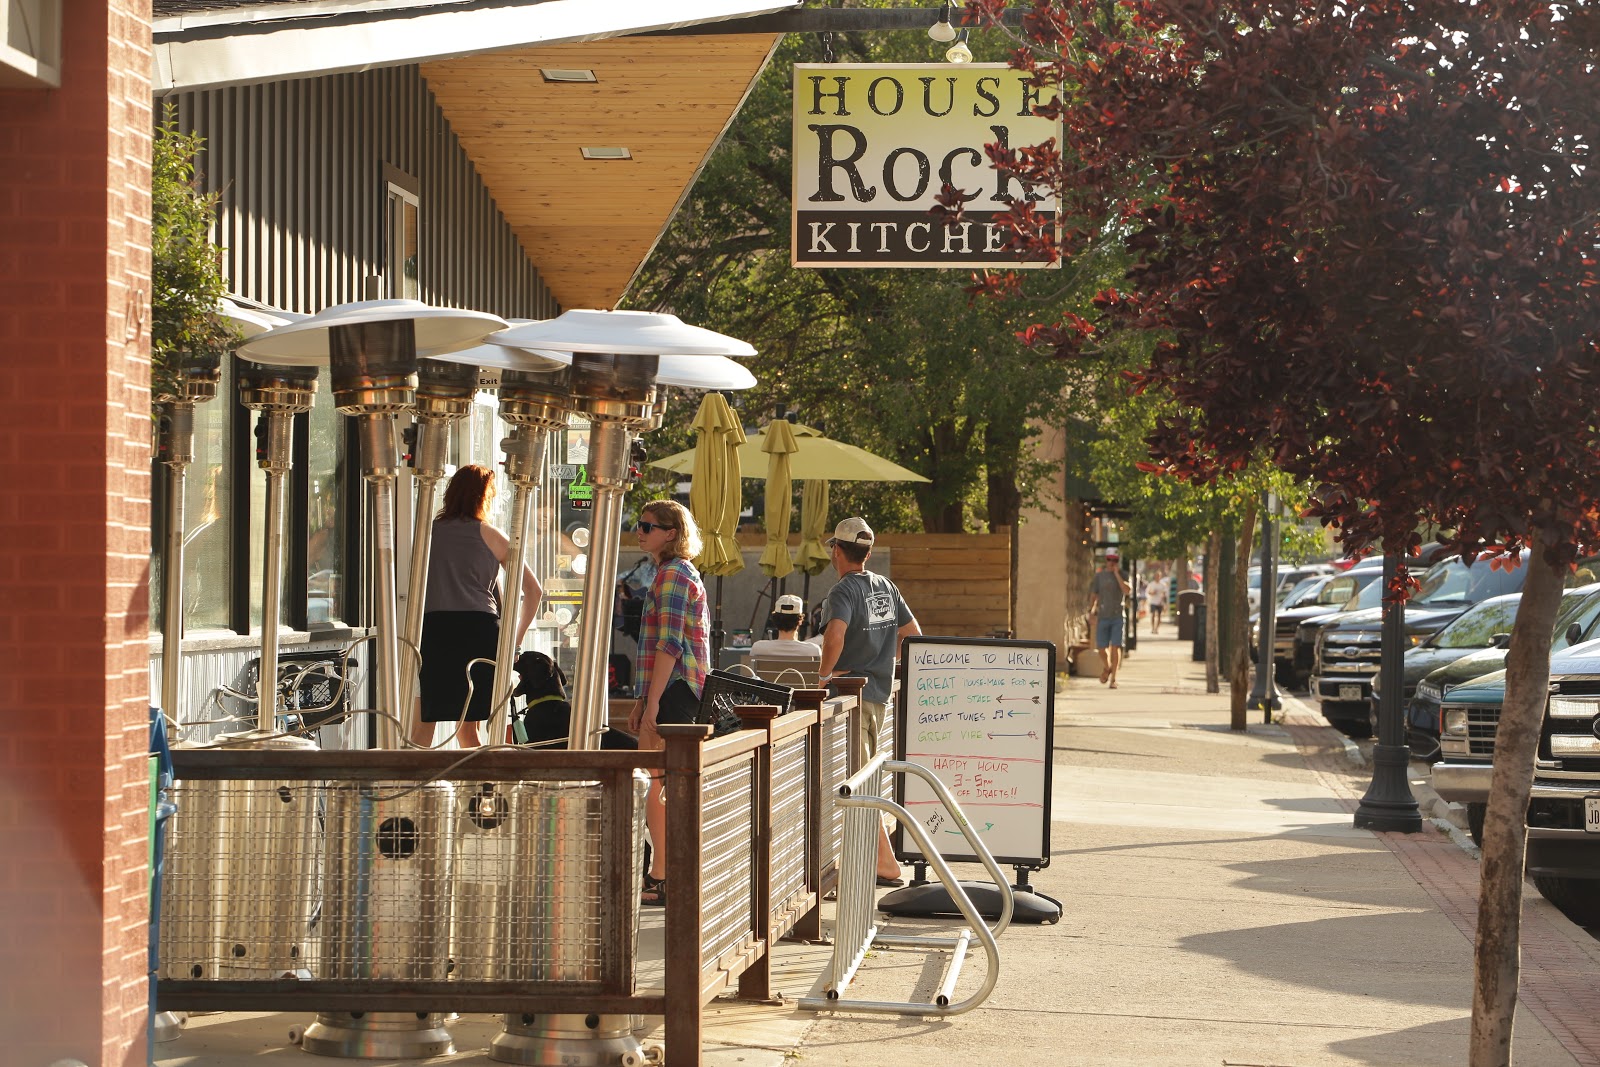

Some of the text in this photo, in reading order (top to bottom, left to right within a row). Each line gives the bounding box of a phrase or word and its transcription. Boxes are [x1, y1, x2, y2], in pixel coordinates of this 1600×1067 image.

[807, 76, 1042, 117] HOUSE
[807, 222, 1044, 253] KITCHE
[914, 650, 1041, 667] WELCOME TO HRK!
[916, 677, 956, 691] GREAT
[1011, 677, 1027, 686] FOOD
[917, 694, 958, 707] GREAT
[918, 712, 986, 725] GREAT TUNES
[917, 731, 952, 743] GREAT
[933, 758, 1009, 774] HAPPY HOUR
